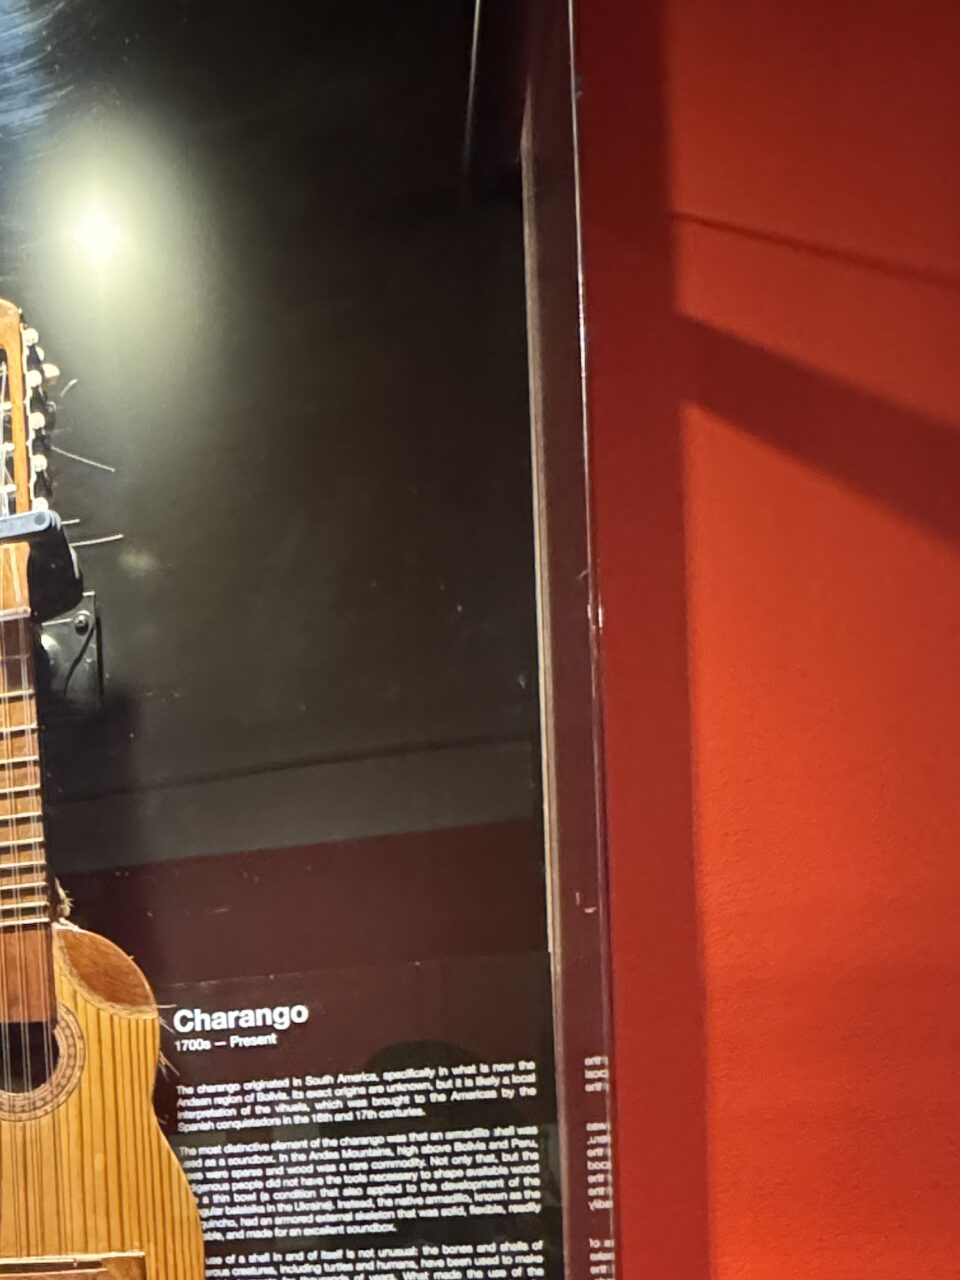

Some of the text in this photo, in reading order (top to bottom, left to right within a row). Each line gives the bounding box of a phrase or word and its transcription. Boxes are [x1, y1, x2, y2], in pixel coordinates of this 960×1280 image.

[173, 1005, 309, 1033] Charango
[174, 1038, 212, 1052] 1700s
[229, 1032, 278, 1048] Present
[176, 1095, 212, 1106] Andean
[212, 1093, 243, 1105] region
[304, 1087, 333, 1098] exact
[333, 1085, 367, 1097] origins
[475, 1076, 500, 1088] likely
[511, 1074, 536, 1084] local
[196, 1081, 241, 1094] charango
[242, 1078, 290, 1091] originated
[304, 1075, 334, 1085] South
[451, 1065, 477, 1075] what
[313, 1099, 343, 1110] which
[371, 1095, 410, 1107] brought
[449, 1089, 497, 1101] Americas
[178, 1120, 215, 1132] Spanish
[310, 1112, 333, 1122] 16th
[355, 1109, 378, 1119] 17th
[197, 1144, 222, 1153] most
[270, 1138, 309, 1149] element
[338, 1134, 385, 1147] charango
[407, 1131, 428, 1141] that
[444, 1128, 490, 1139] armadillo
[493, 1126, 515, 1136] shell
[308, 1150, 340, 1160] Andes
[396, 1145, 419, 1157] high
[420, 1144, 452, 1154] above
[453, 1142, 486, 1152] Bolivia
[204, 1170, 229, 1178] were
[230, 1168, 263, 1178] sparse
[285, 1164, 314, 1174] wood
[348, 1162, 369, 1170] rare
[450, 1155, 473, 1166] only
[230, 1179, 264, 1190] people
[299, 1176, 325, 1185] have
[343, 1173, 368, 1183] tools
[368, 1172, 418, 1183] necessary
[432, 1168, 464, 1180] shape
[464, 1166, 509, 1177] available
[509, 1164, 540, 1175] wood
[245, 1228, 273, 1237] made
[302, 1225, 345, 1235] excellent
[247, 1252, 270, 1261] shell
[320, 1249, 343, 1258] itself
[441, 1244, 473, 1253] bones
[499, 1241, 529, 1251] shells
[279, 1263, 322, 1275] including
[323, 1262, 354, 1271] turtles
[420, 1258, 445, 1268] have
[446, 1257, 472, 1267] been
[473, 1256, 500, 1266] used
[514, 1254, 544, 1264] make
